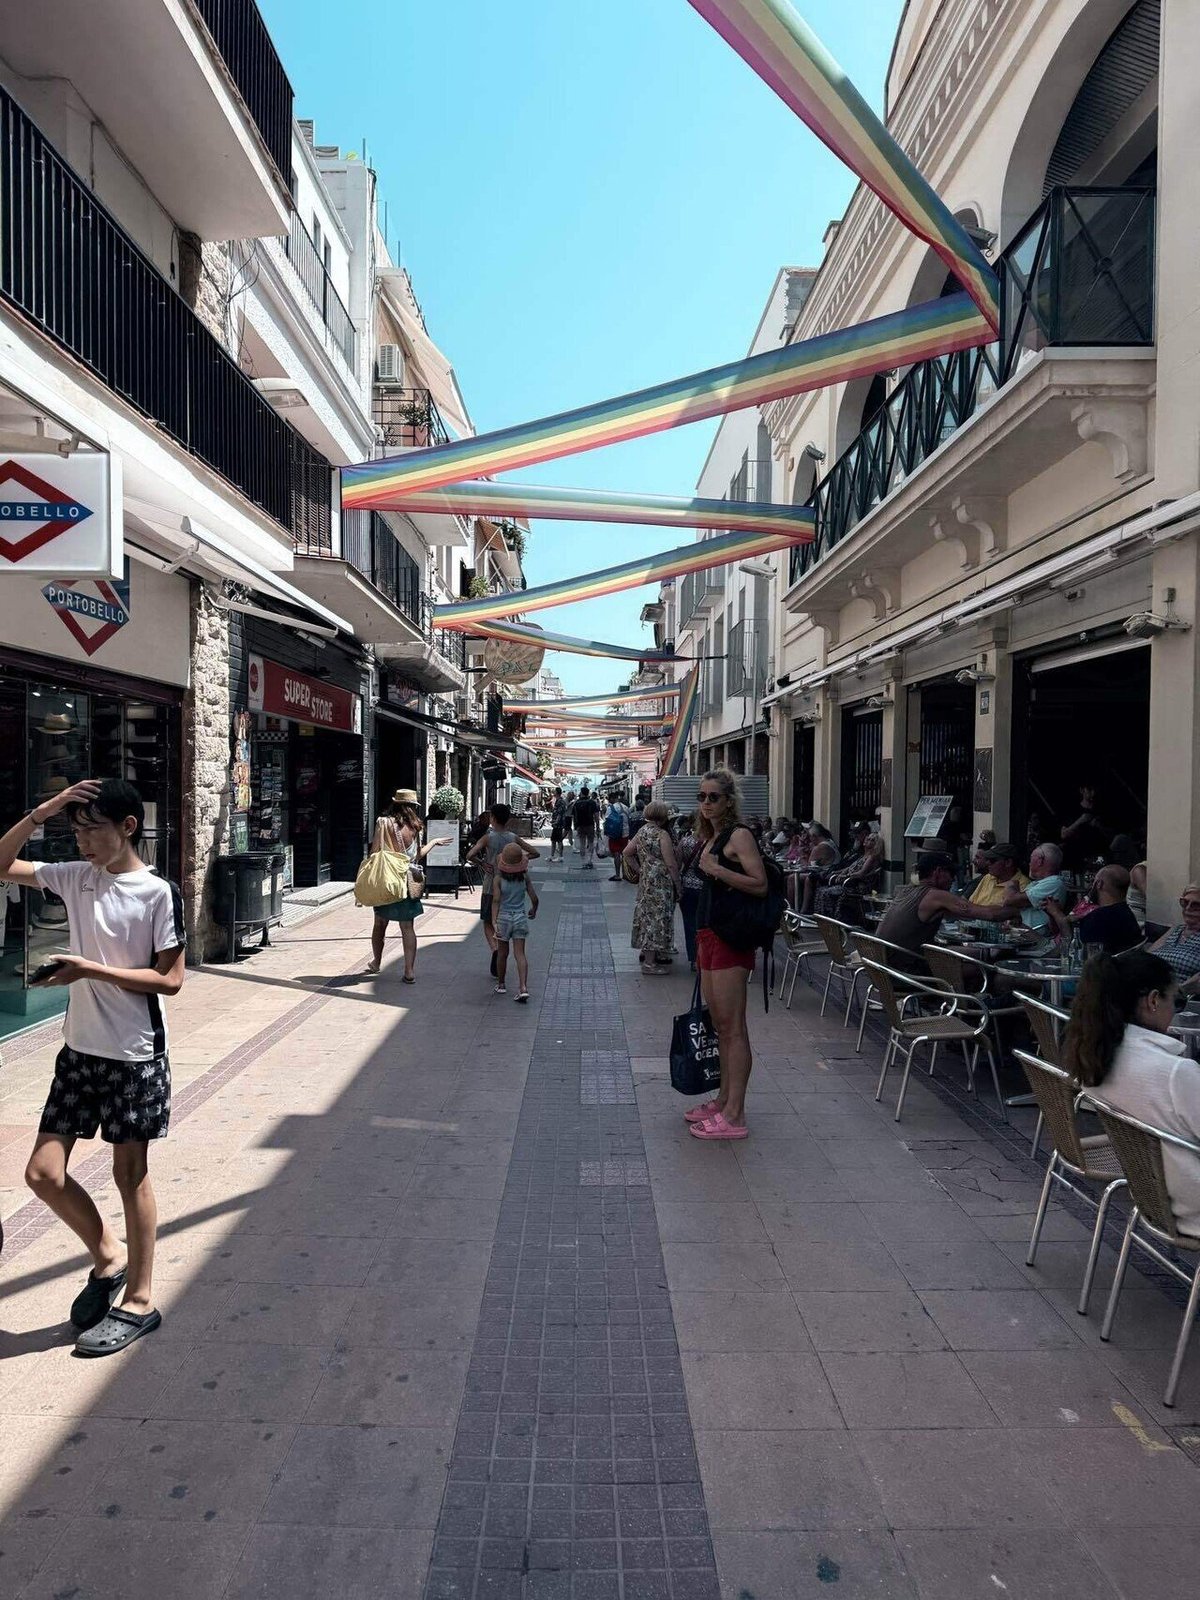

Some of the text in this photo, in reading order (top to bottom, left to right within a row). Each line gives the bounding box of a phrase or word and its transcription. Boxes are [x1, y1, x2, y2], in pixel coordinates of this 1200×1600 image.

[48, 586, 124, 623] PORTOBELLO
[284, 678, 311, 708] SUPER
[311, 697, 334, 722] STORE
[689, 1021, 707, 1036] SA
[691, 1036, 708, 1050] VE
